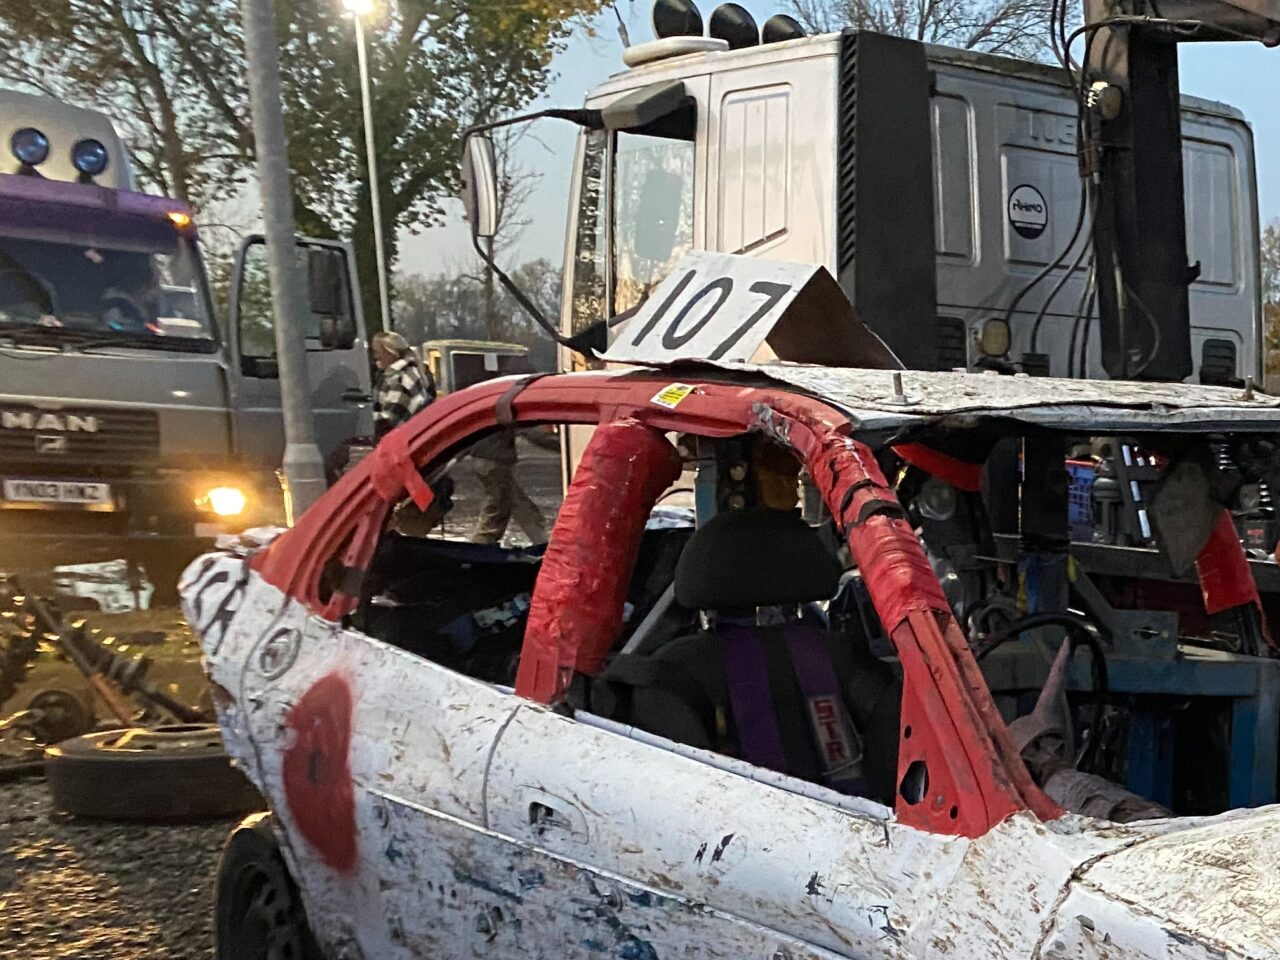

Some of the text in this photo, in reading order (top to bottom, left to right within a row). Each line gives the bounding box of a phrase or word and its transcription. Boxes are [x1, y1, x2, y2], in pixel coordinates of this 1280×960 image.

[631, 269, 793, 361] 107
[1, 411, 98, 433] MAN
[813, 699, 849, 763] STR
